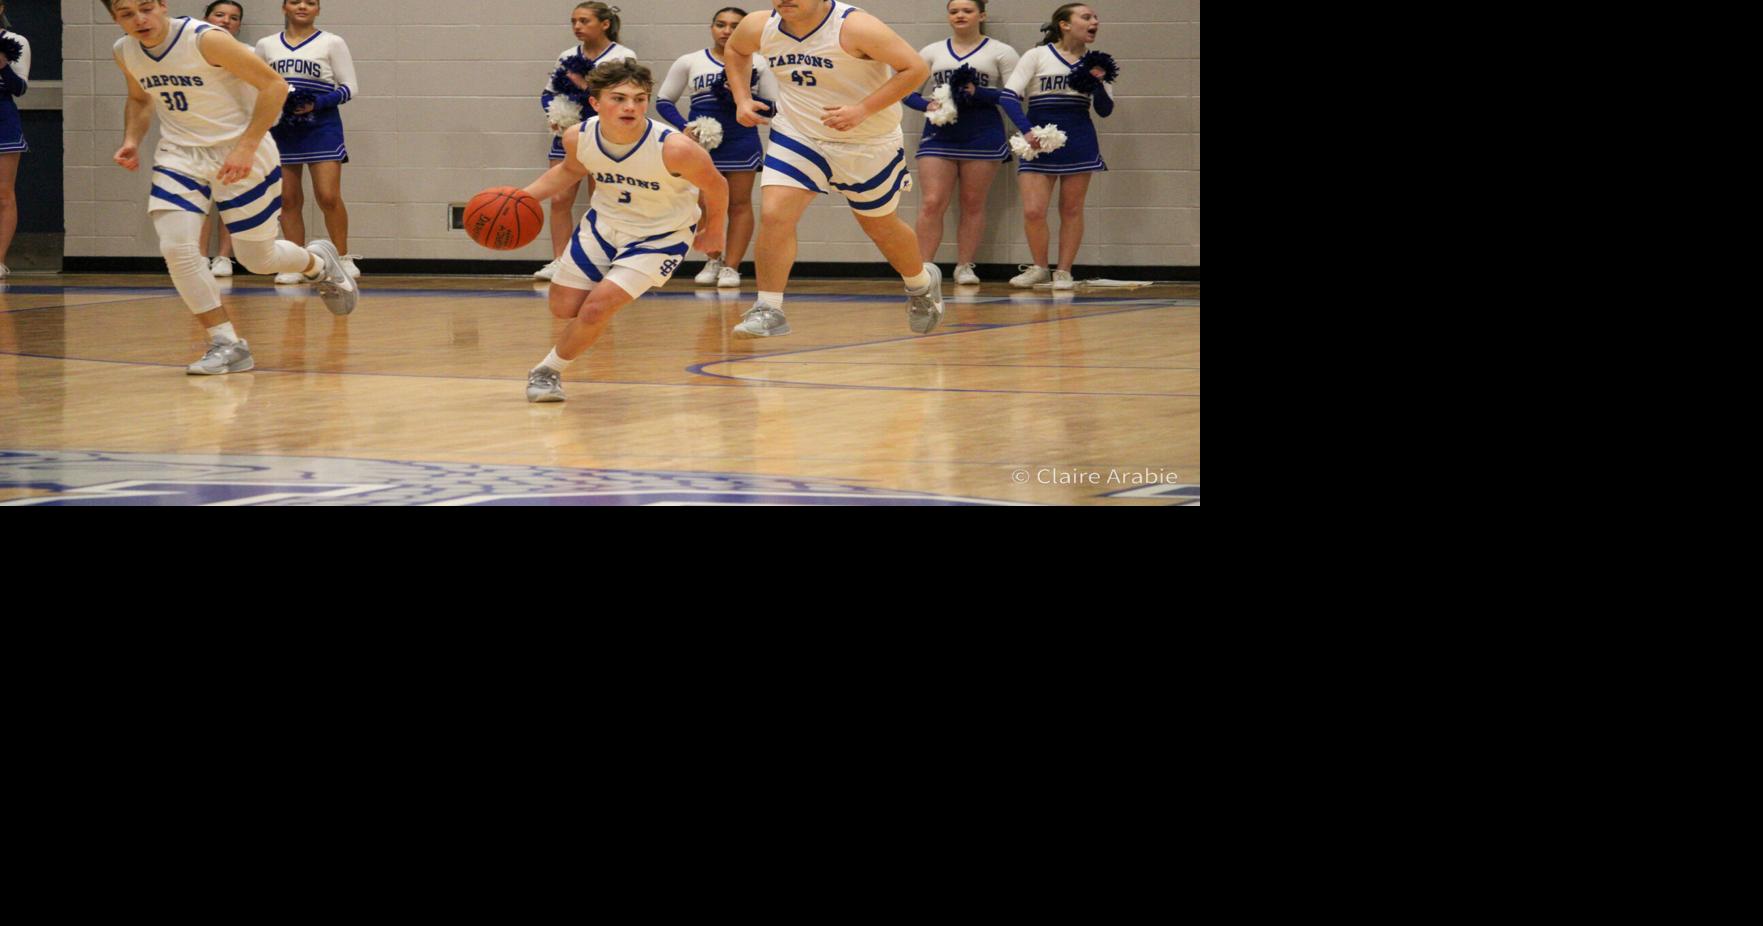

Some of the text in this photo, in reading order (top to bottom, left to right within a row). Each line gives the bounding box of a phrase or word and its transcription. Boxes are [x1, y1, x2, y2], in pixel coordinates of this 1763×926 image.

[270, 59, 321, 78] ARPONS
[769, 54, 834, 69] TARPONS
[791, 70, 816, 86] 45
[160, 91, 188, 111] 30
[592, 172, 660, 191] ARPONS
[618, 191, 632, 203] 3
